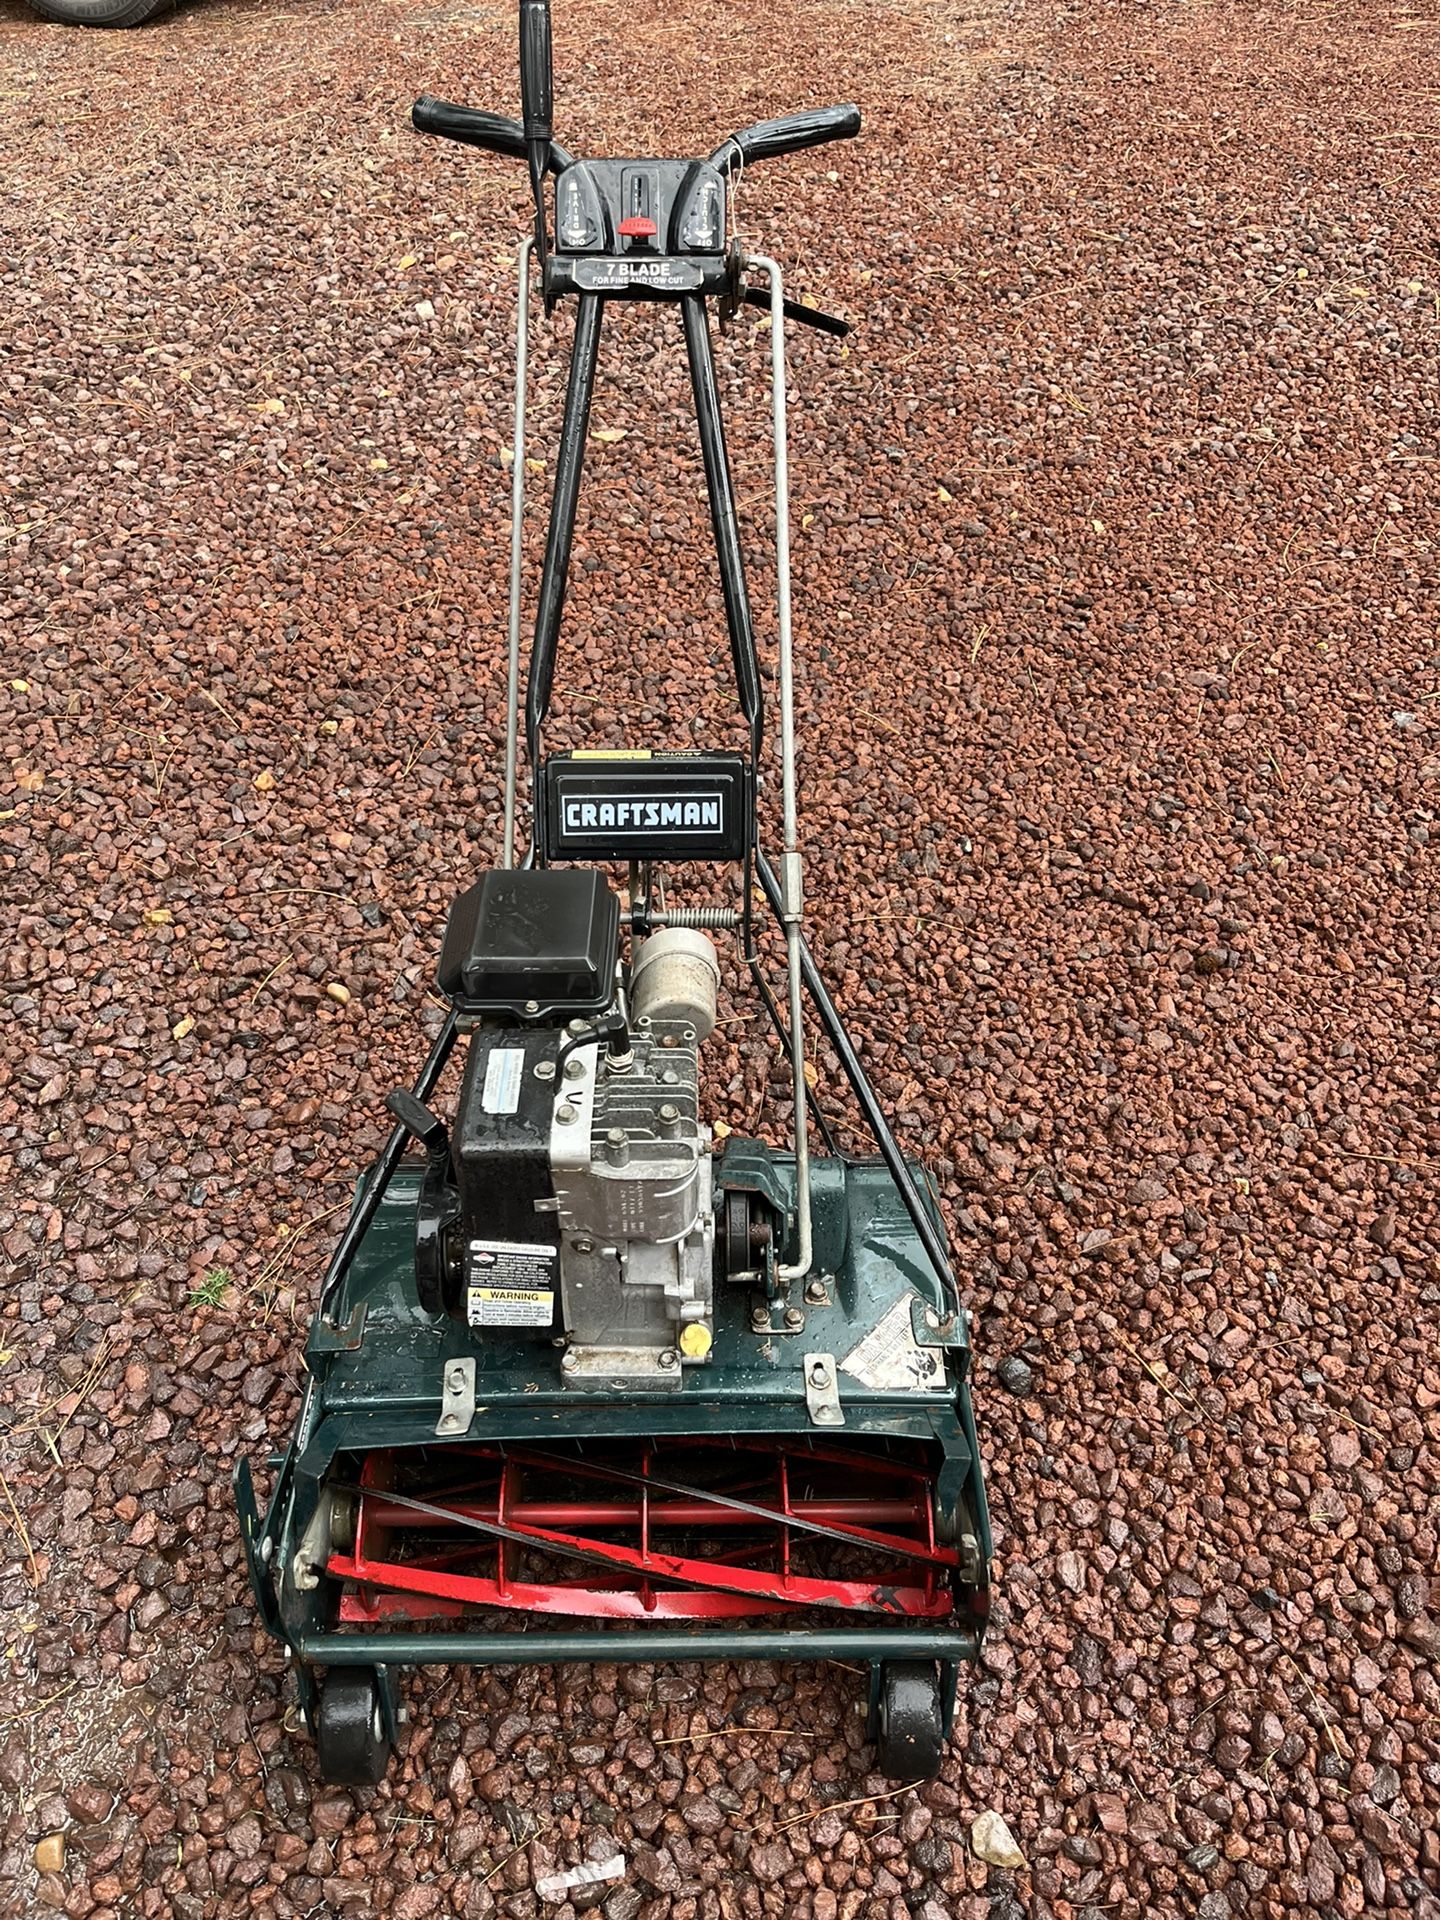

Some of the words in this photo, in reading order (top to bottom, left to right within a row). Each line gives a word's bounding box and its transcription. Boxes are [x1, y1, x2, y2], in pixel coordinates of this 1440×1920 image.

[607, 264, 614, 275] 7
[619, 264, 670, 276] BLADE
[592, 276, 609, 284] FOR
[610, 276, 629, 284] FINE
[630, 276, 647, 284] AND
[648, 276, 667, 284] LOW
[668, 276, 684, 284] CUT
[567, 802, 718, 827] CRAFTSMAN
[490, 1290, 539, 1301] WARNING
